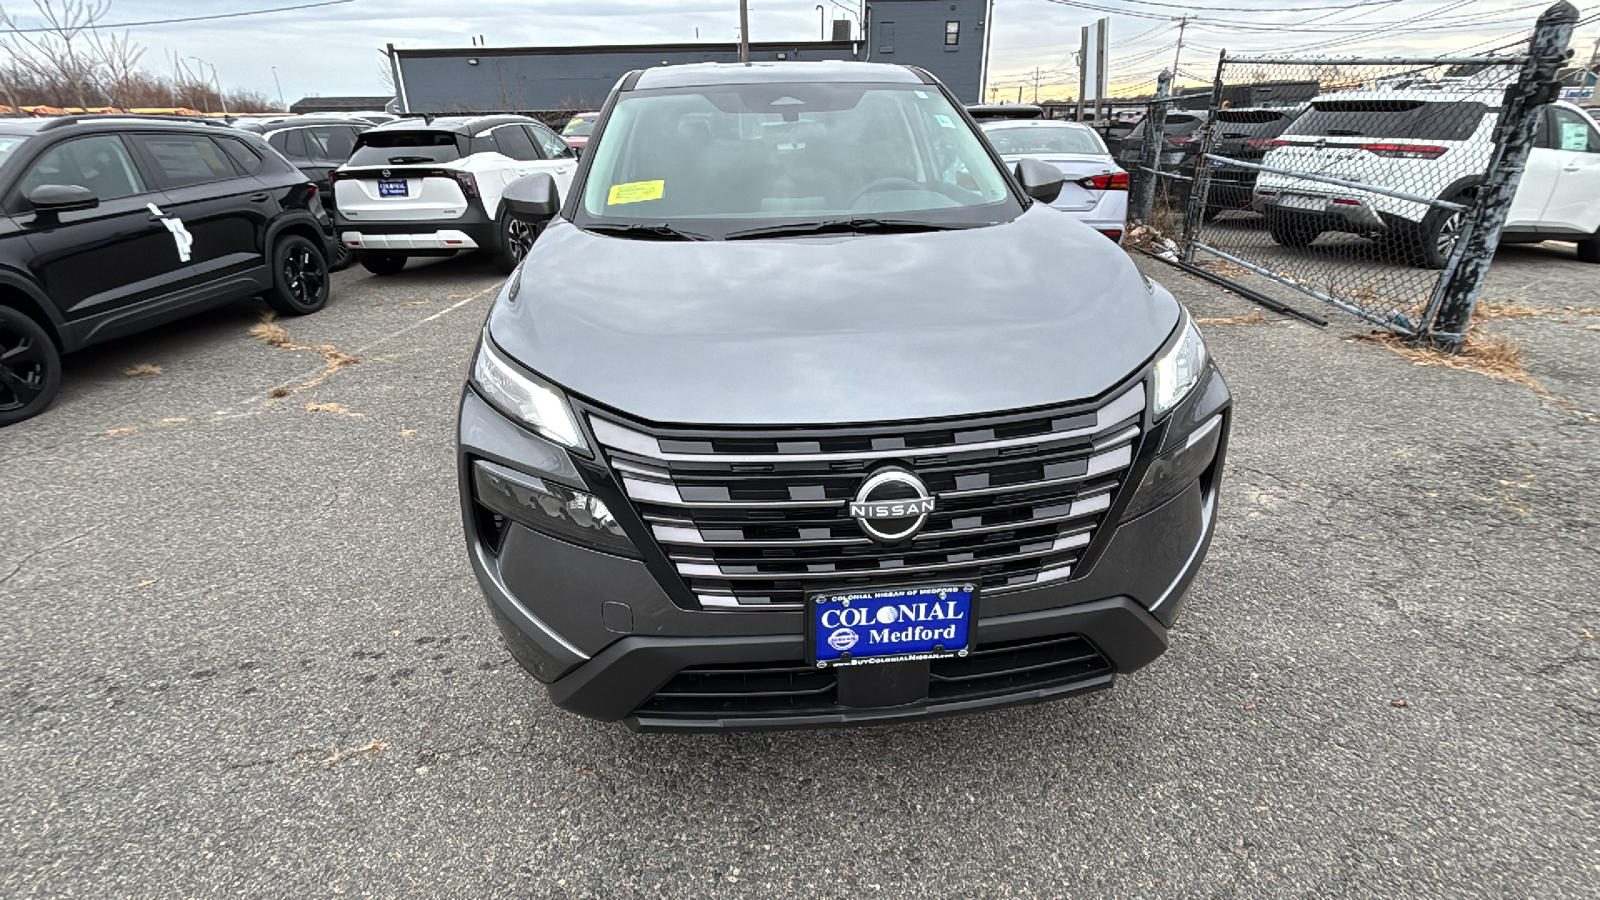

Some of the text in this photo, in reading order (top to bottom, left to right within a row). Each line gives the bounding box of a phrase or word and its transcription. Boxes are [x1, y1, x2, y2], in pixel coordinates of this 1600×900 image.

[851, 500, 934, 517] NISSAN
[831, 594, 872, 602] COLONIAL
[920, 587, 959, 595] MEDFORD
[821, 601, 964, 628] COLONIAL
[869, 625, 955, 644] Medford
